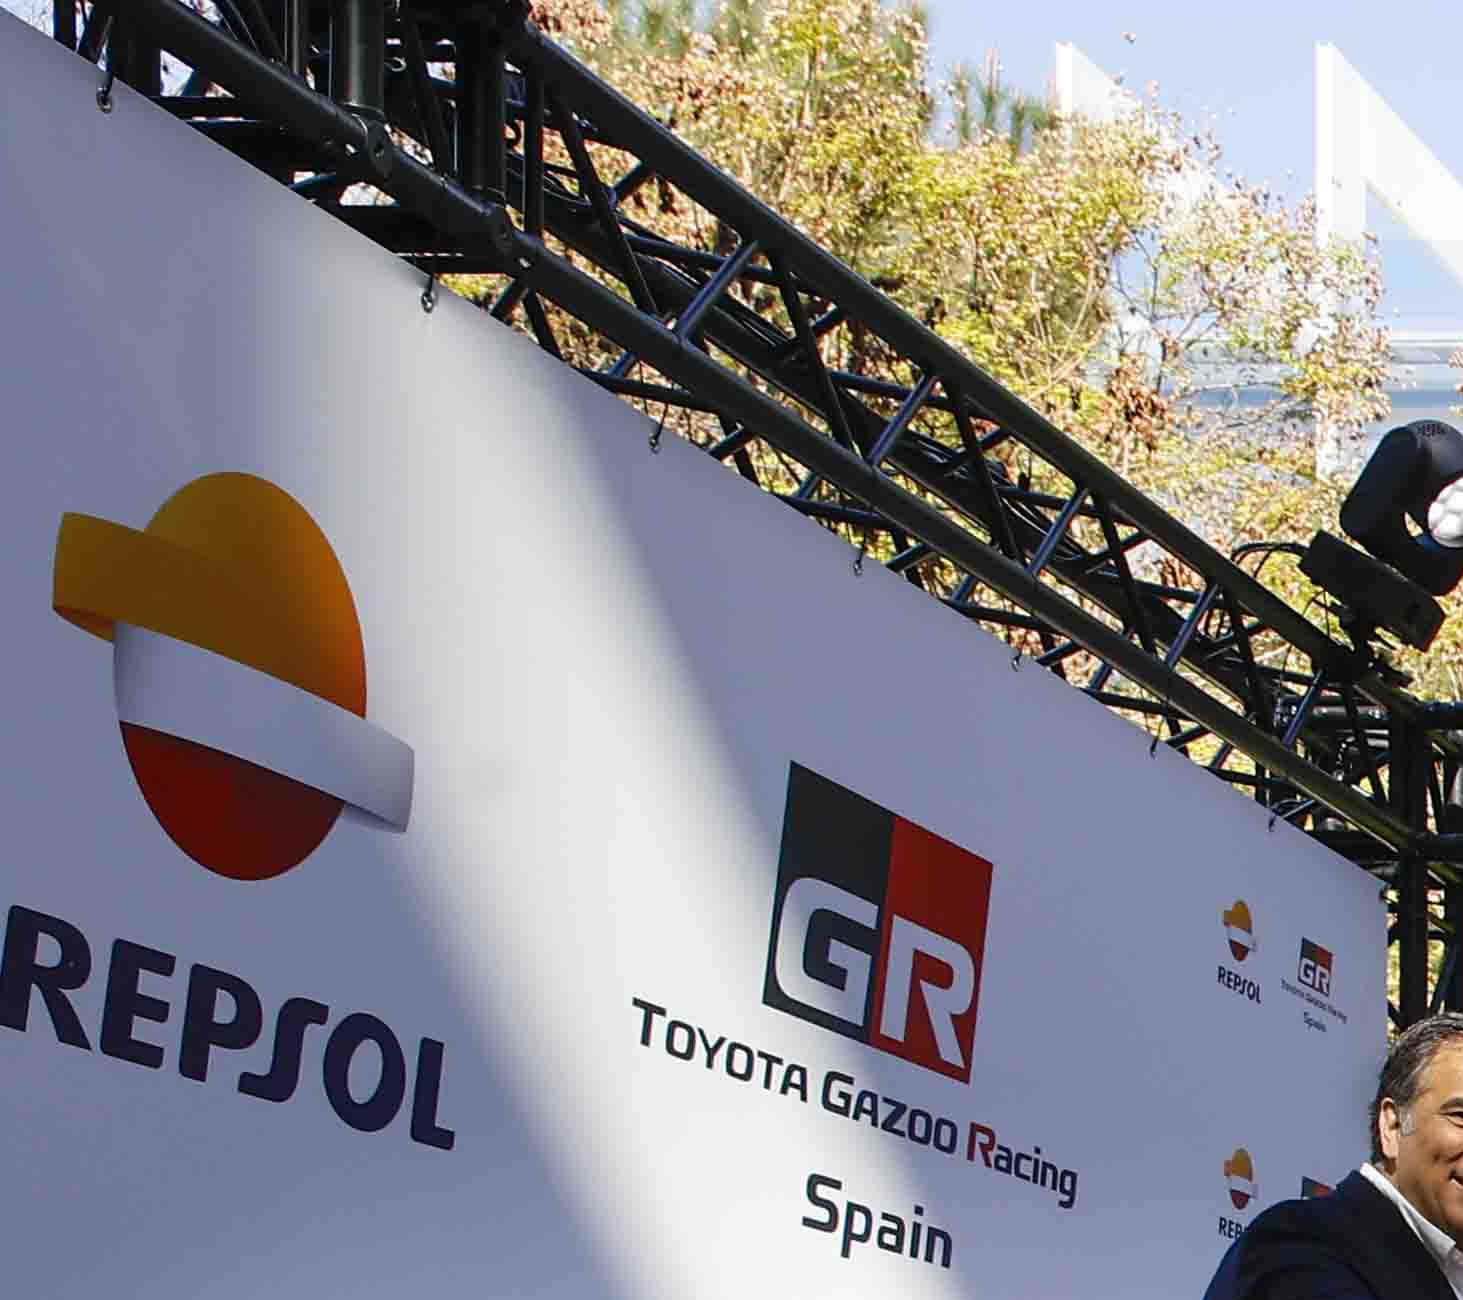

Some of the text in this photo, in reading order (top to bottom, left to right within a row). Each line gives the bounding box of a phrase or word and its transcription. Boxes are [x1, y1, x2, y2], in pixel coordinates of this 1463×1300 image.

[776, 877, 974, 1069] GR
[1218, 966, 1261, 1004] REPSOL
[1300, 958, 1329, 993] GR
[0, 905, 454, 1150] REPSOL
[632, 997, 1077, 1209] TOYOTA GAZOO Racing
[802, 1173, 952, 1269] Spain
[1219, 1216, 1242, 1240] REP
